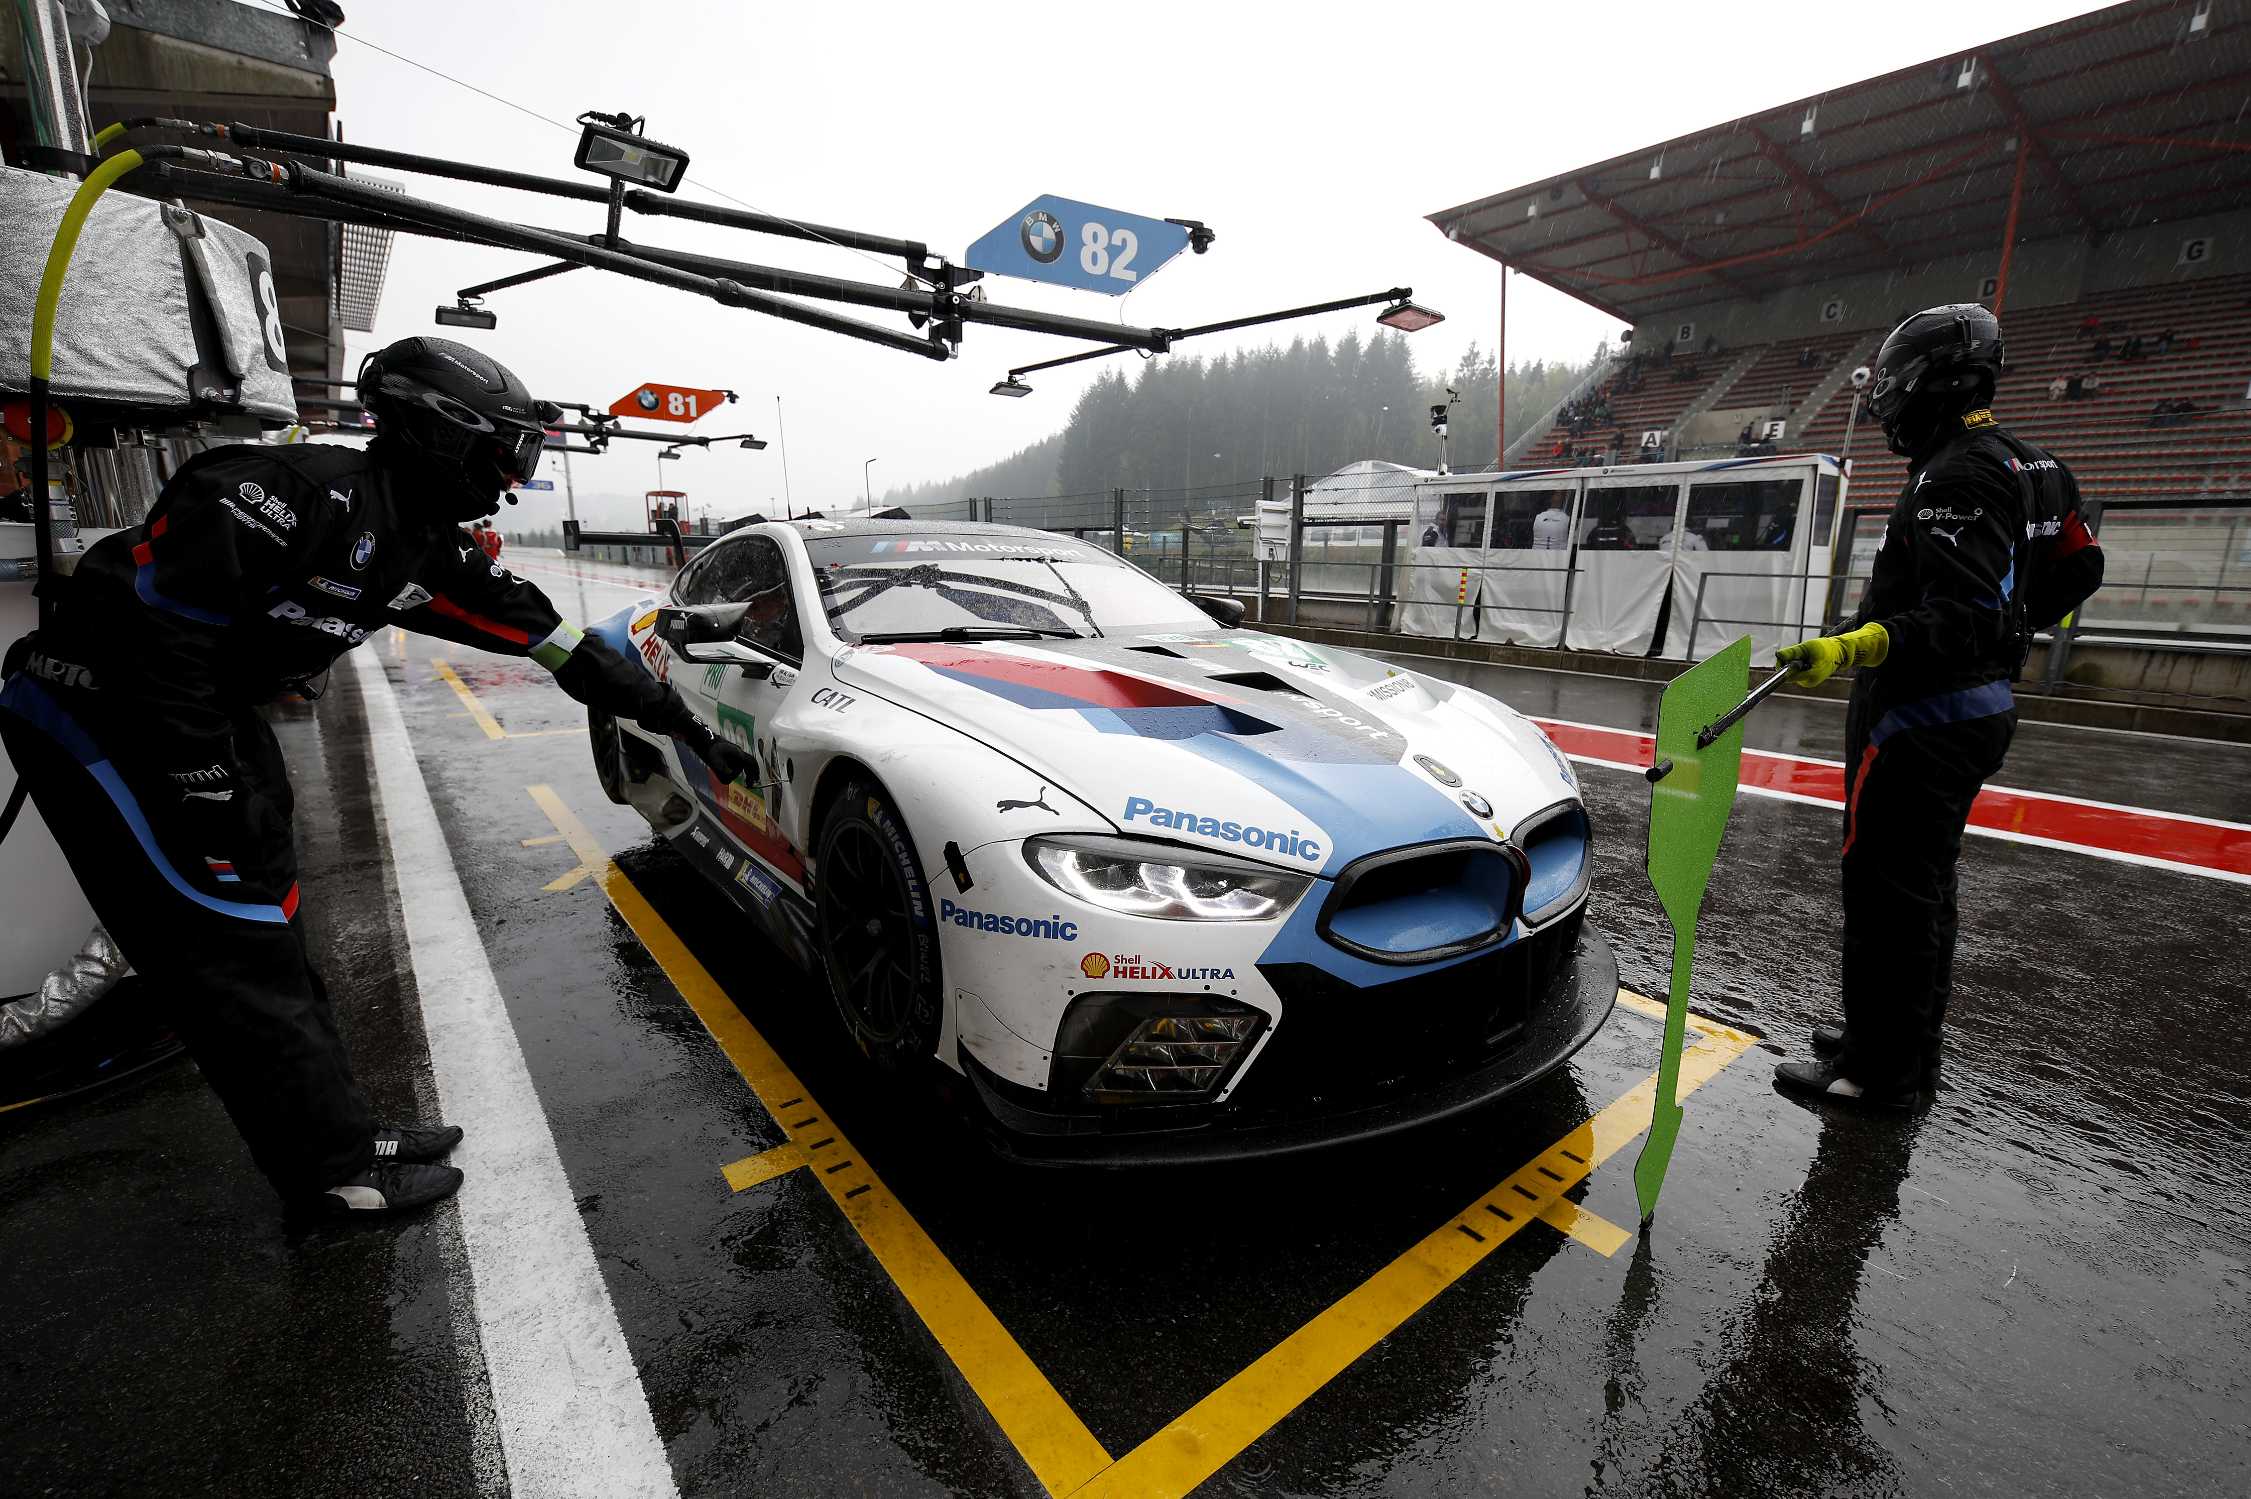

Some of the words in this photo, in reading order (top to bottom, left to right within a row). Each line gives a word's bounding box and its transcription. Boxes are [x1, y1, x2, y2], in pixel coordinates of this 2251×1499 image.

[1080, 222, 1138, 282] 82
[2186, 240, 2205, 261] G
[1825, 303, 1838, 319] C
[1680, 325, 1692, 340] B
[454, 360, 489, 384] Motorsport
[668, 392, 697, 417] 81
[1645, 432, 1658, 447] A
[1768, 423, 1780, 438] E
[269, 495, 288, 509] Shell
[260, 505, 292, 531] ULTRA
[811, 687, 857, 714] CATL
[1123, 796, 1321, 862] Panasonic
[882, 818, 926, 918] MICHELIN
[940, 897, 1078, 941] Panasonic
[1113, 954, 1141, 965] Shell
[1113, 960, 1176, 980] HELIX
[1177, 967, 1235, 980] ULTRA
